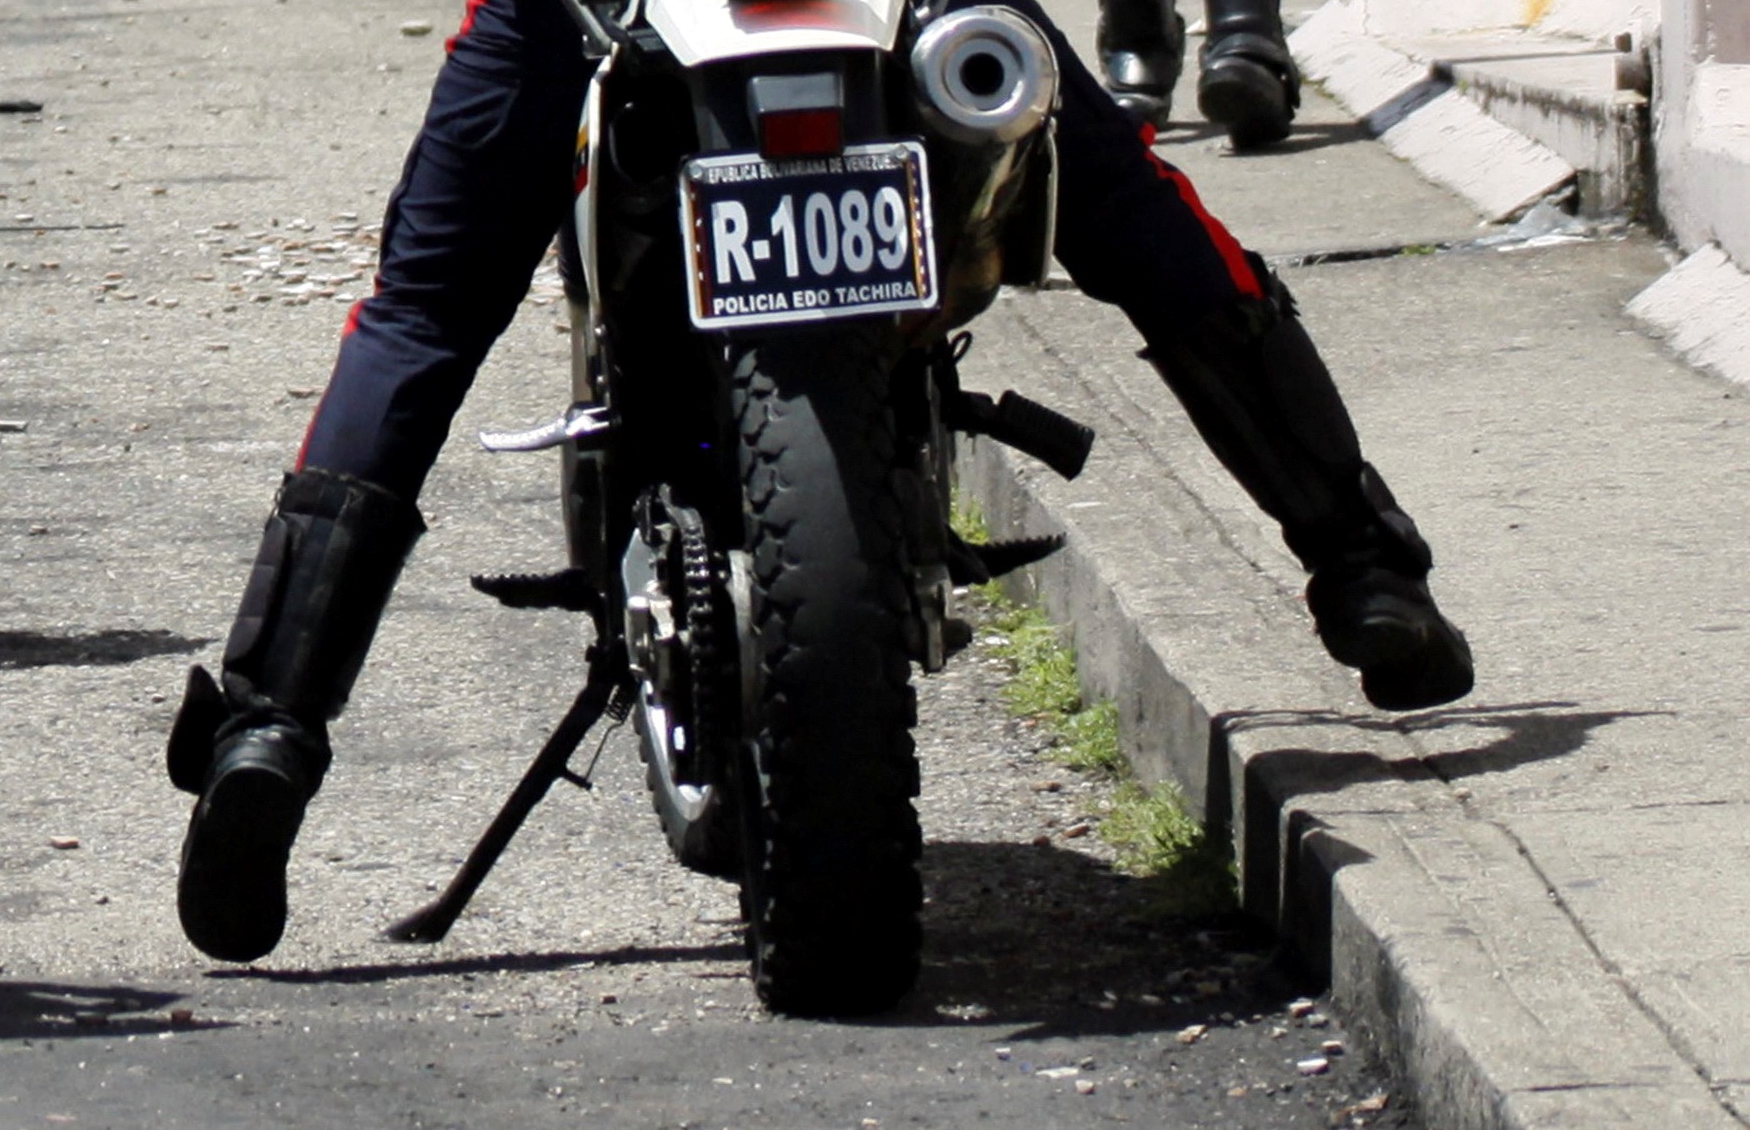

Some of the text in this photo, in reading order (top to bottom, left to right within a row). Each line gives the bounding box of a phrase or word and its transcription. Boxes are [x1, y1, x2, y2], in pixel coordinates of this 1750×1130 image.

[703, 163, 759, 184] EPUBLICA
[828, 156, 844, 174] DE
[711, 186, 908, 284] R-1089
[713, 281, 916, 315] POLICIA EDO TACHIRA
